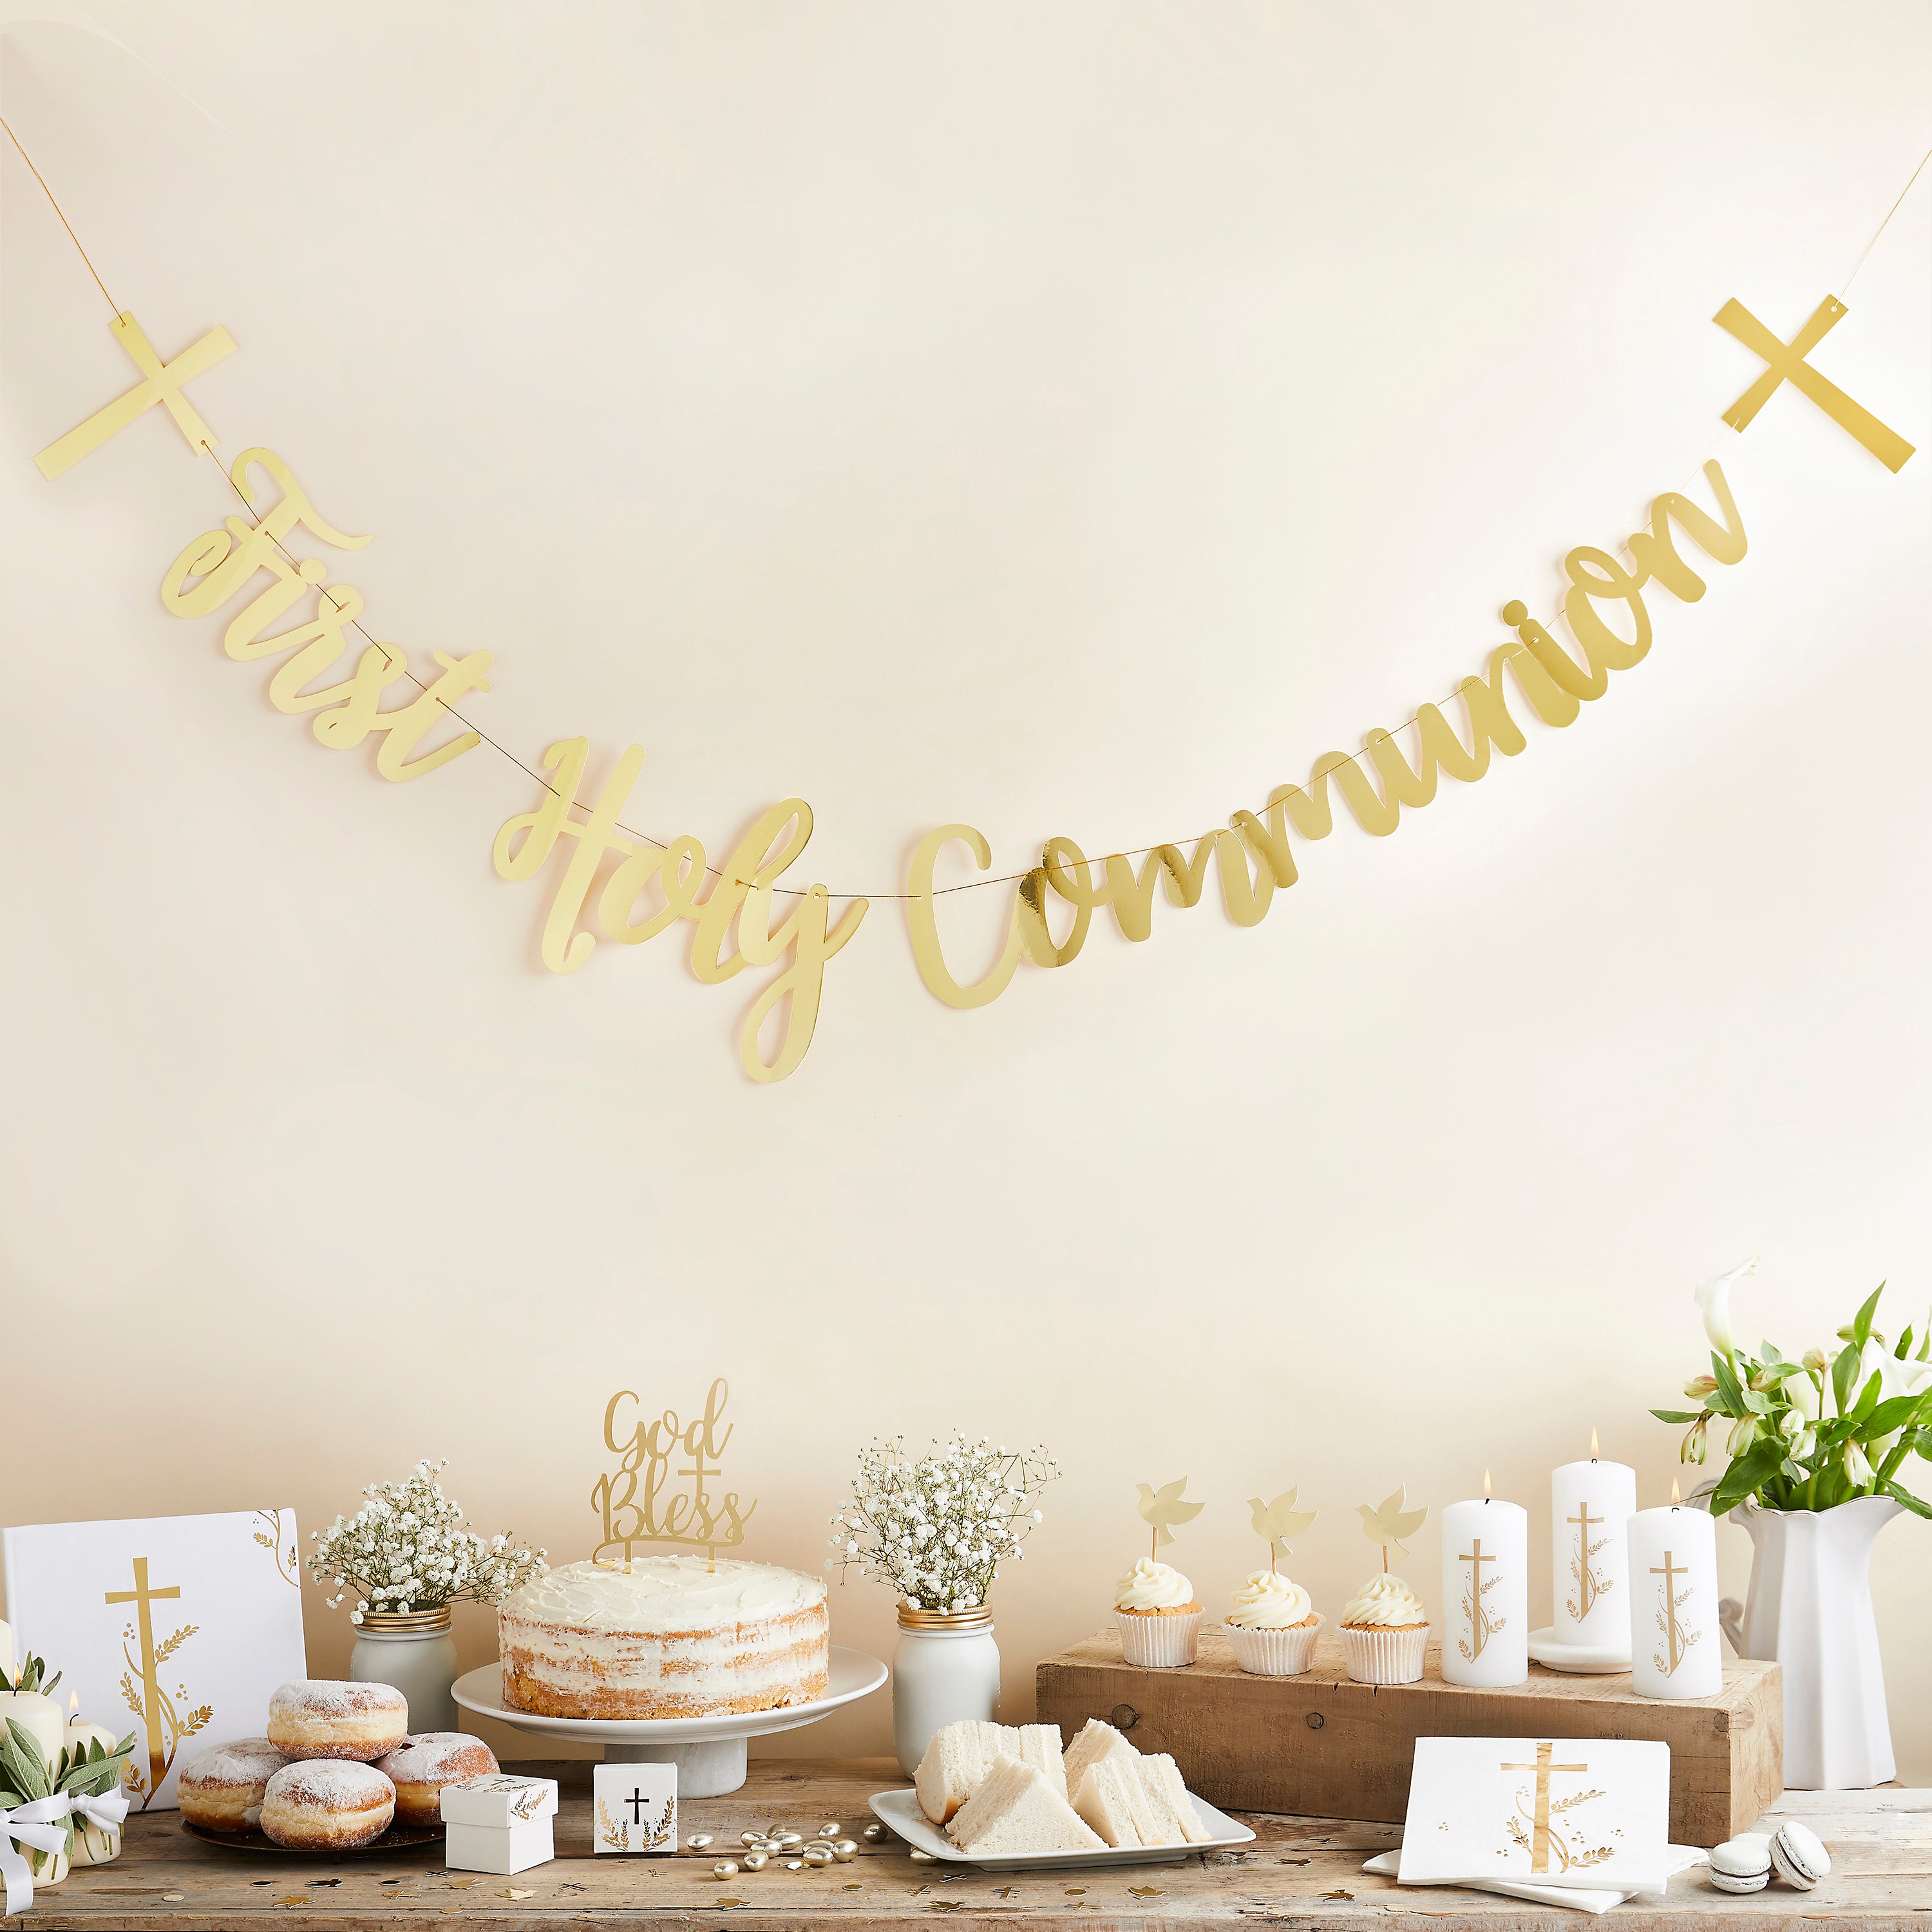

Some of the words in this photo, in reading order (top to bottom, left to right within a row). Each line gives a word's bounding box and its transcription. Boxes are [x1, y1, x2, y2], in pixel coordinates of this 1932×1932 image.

[162, 447, 495, 782] First
[493, 735, 869, 1083] Holy
[907, 459, 1748, 1009] Communion
[604, 1378, 734, 1472] God
[591, 1457, 758, 1547] Bless
